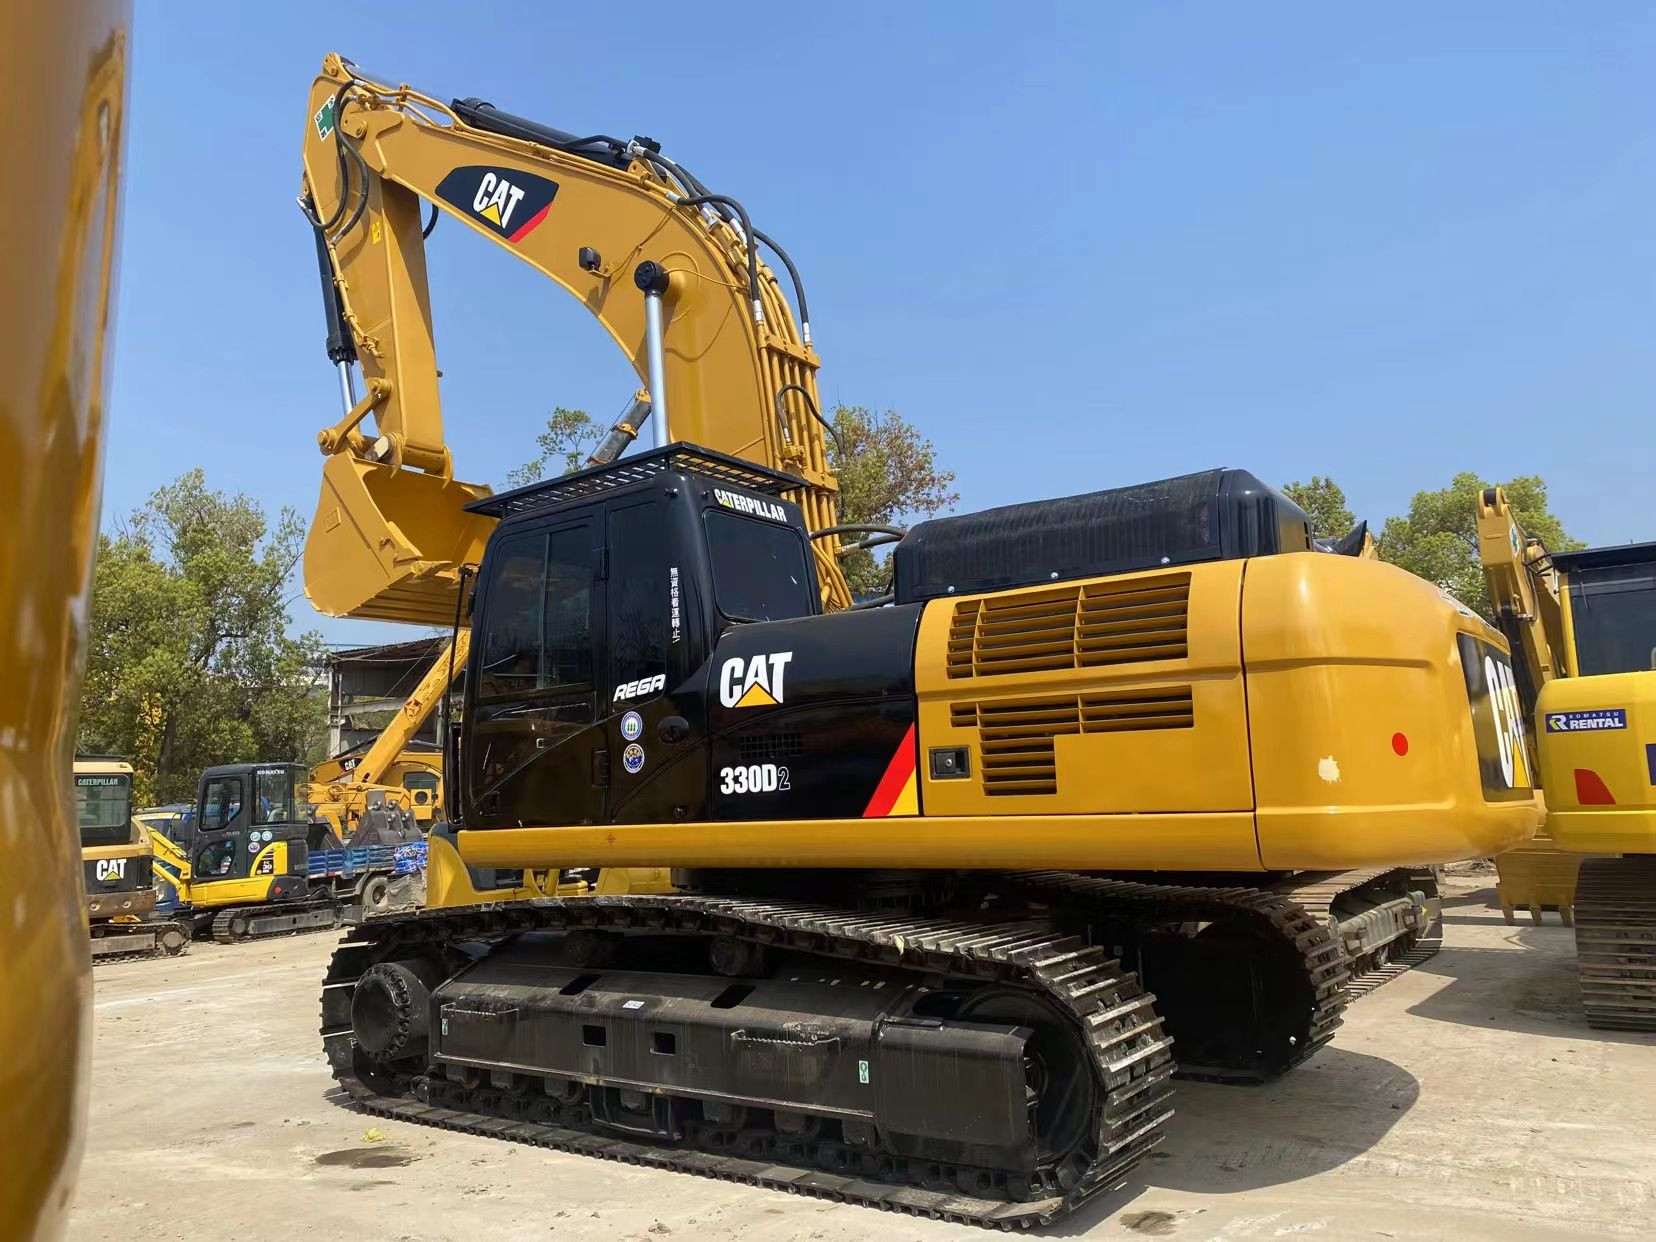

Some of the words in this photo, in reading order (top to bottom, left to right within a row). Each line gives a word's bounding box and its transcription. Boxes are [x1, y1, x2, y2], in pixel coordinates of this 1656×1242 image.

[473, 172, 525, 229] CAT
[714, 488, 788, 523] CATERPILLAR
[613, 673, 666, 702] REGA
[720, 652, 793, 708] CAT
[1569, 712, 1619, 720] KOMATSU
[1569, 718, 1624, 730] RENTAL
[77, 778, 119, 786] CATERPILLAR
[96, 858, 127, 881] CAT
